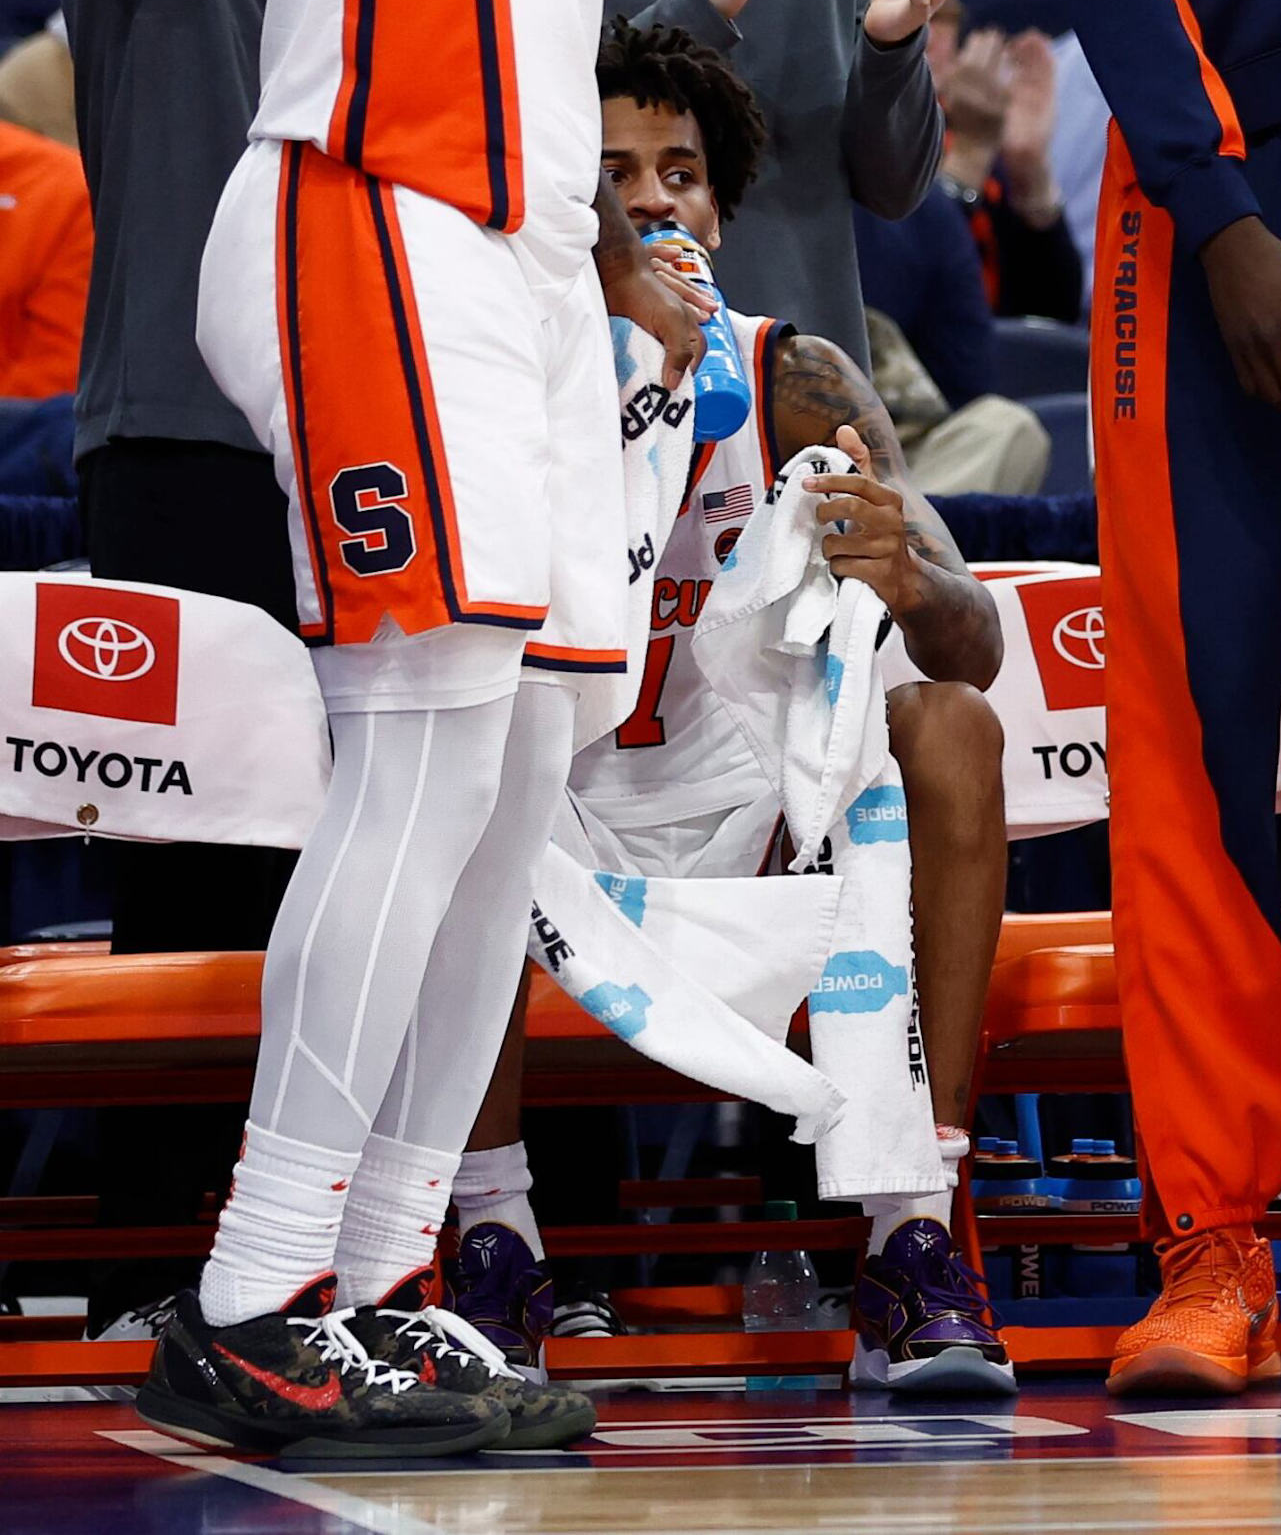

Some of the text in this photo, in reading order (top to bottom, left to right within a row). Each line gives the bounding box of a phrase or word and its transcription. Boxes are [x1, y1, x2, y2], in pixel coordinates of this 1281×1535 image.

[1112, 209, 1144, 422] SYRACUSE
[330, 460, 418, 577] S
[6, 736, 194, 796] TOYOTA
